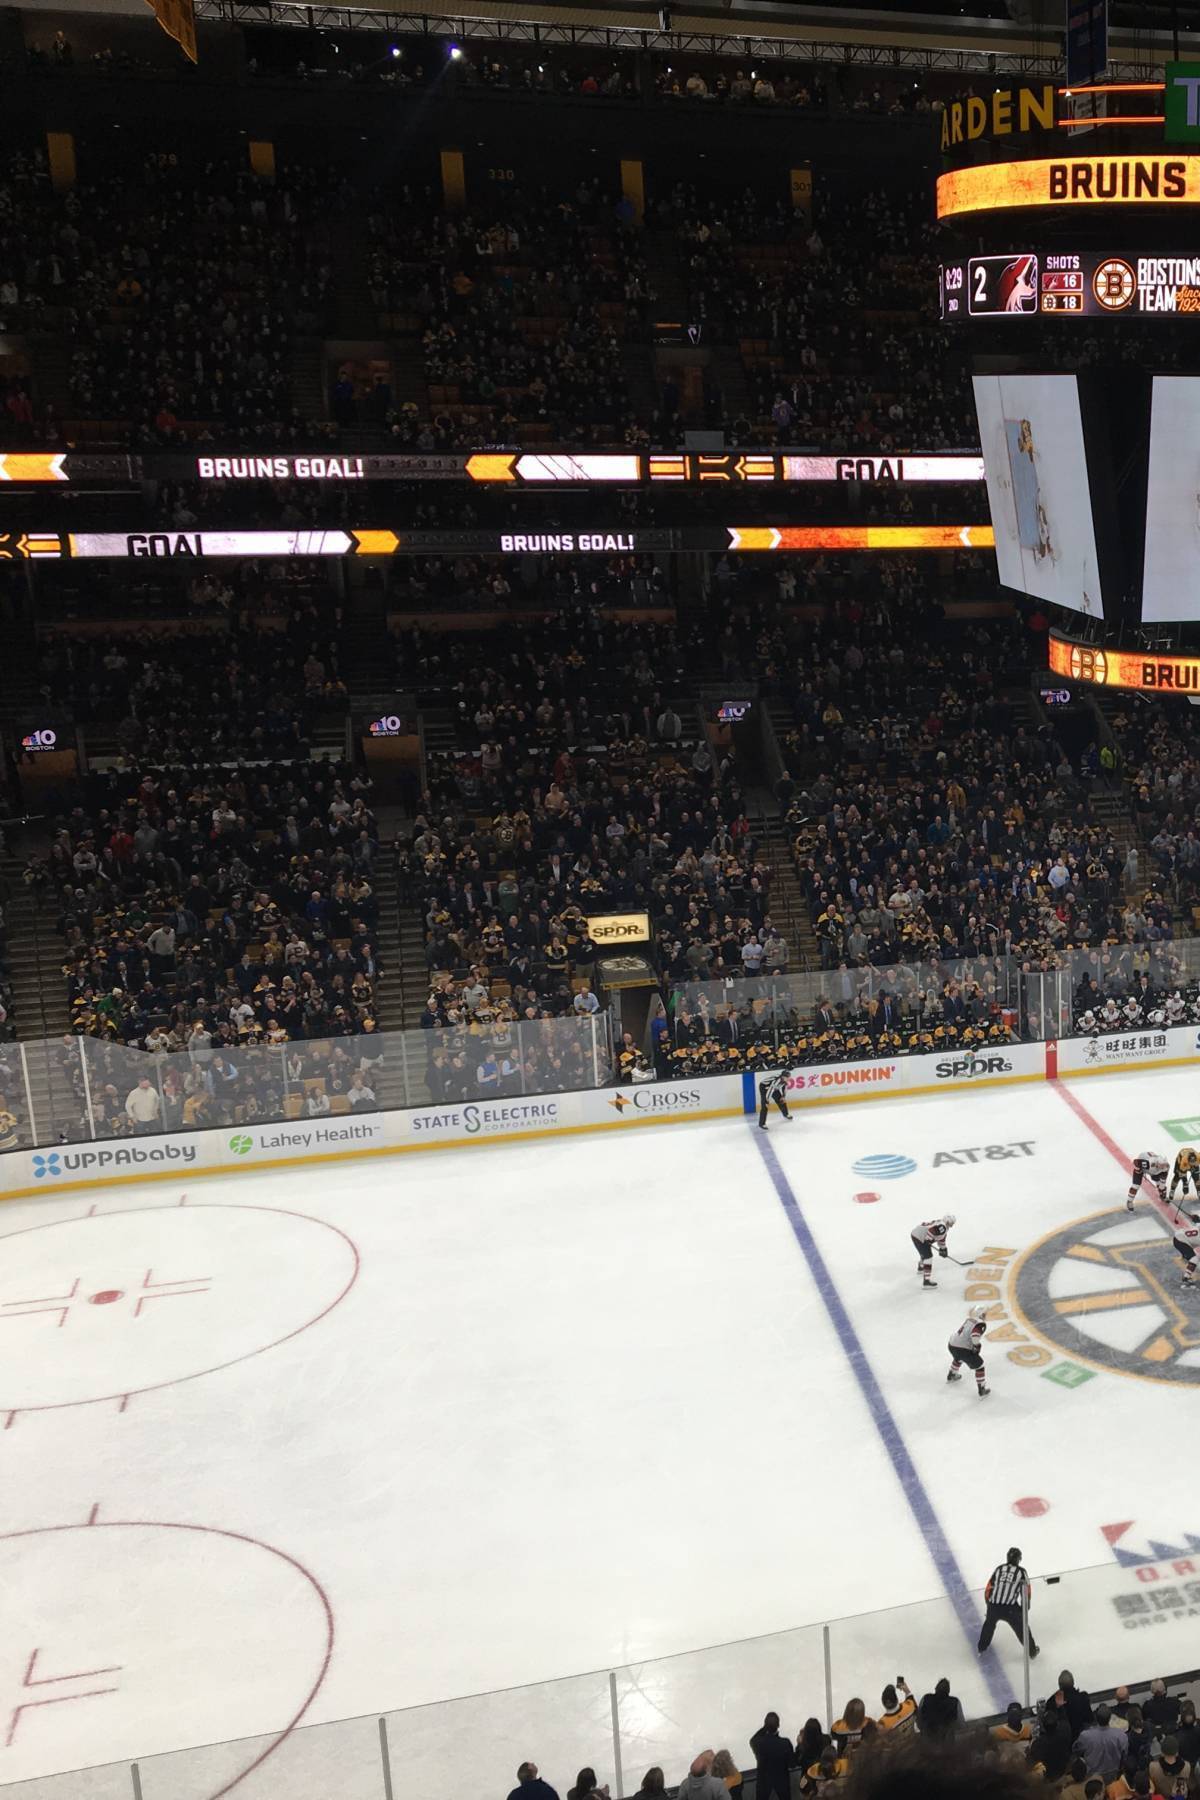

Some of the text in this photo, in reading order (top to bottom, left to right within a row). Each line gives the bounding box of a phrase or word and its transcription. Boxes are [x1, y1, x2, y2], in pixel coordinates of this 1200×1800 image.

[1049, 162, 1187, 200] BRUINS
[1046, 255, 1080, 269] SHOTS
[946, 267, 963, 290] 8:29
[974, 265, 987, 302] 2
[1062, 275, 1077, 288] 16
[1062, 295, 1077, 309] 18
[1137, 286, 1178, 311] TEAM
[198, 457, 364, 478] BRUINS GOAL!
[501, 534, 634, 551] BRUINS GOAL!
[379, 715, 401, 731] 10
[33, 728, 57, 745] 10
[820, 1066, 896, 1087] DUNKIN'
[413, 1103, 558, 1131] STATE ELECTRIC
[485, 1117, 558, 1131] CORPORATION
[260, 1125, 374, 1150] Lahey Health
[63, 1143, 196, 1171] UPPAbaby
[931, 1140, 1037, 1169] AT&T
[1122, 1614, 1168, 1630] ORG
